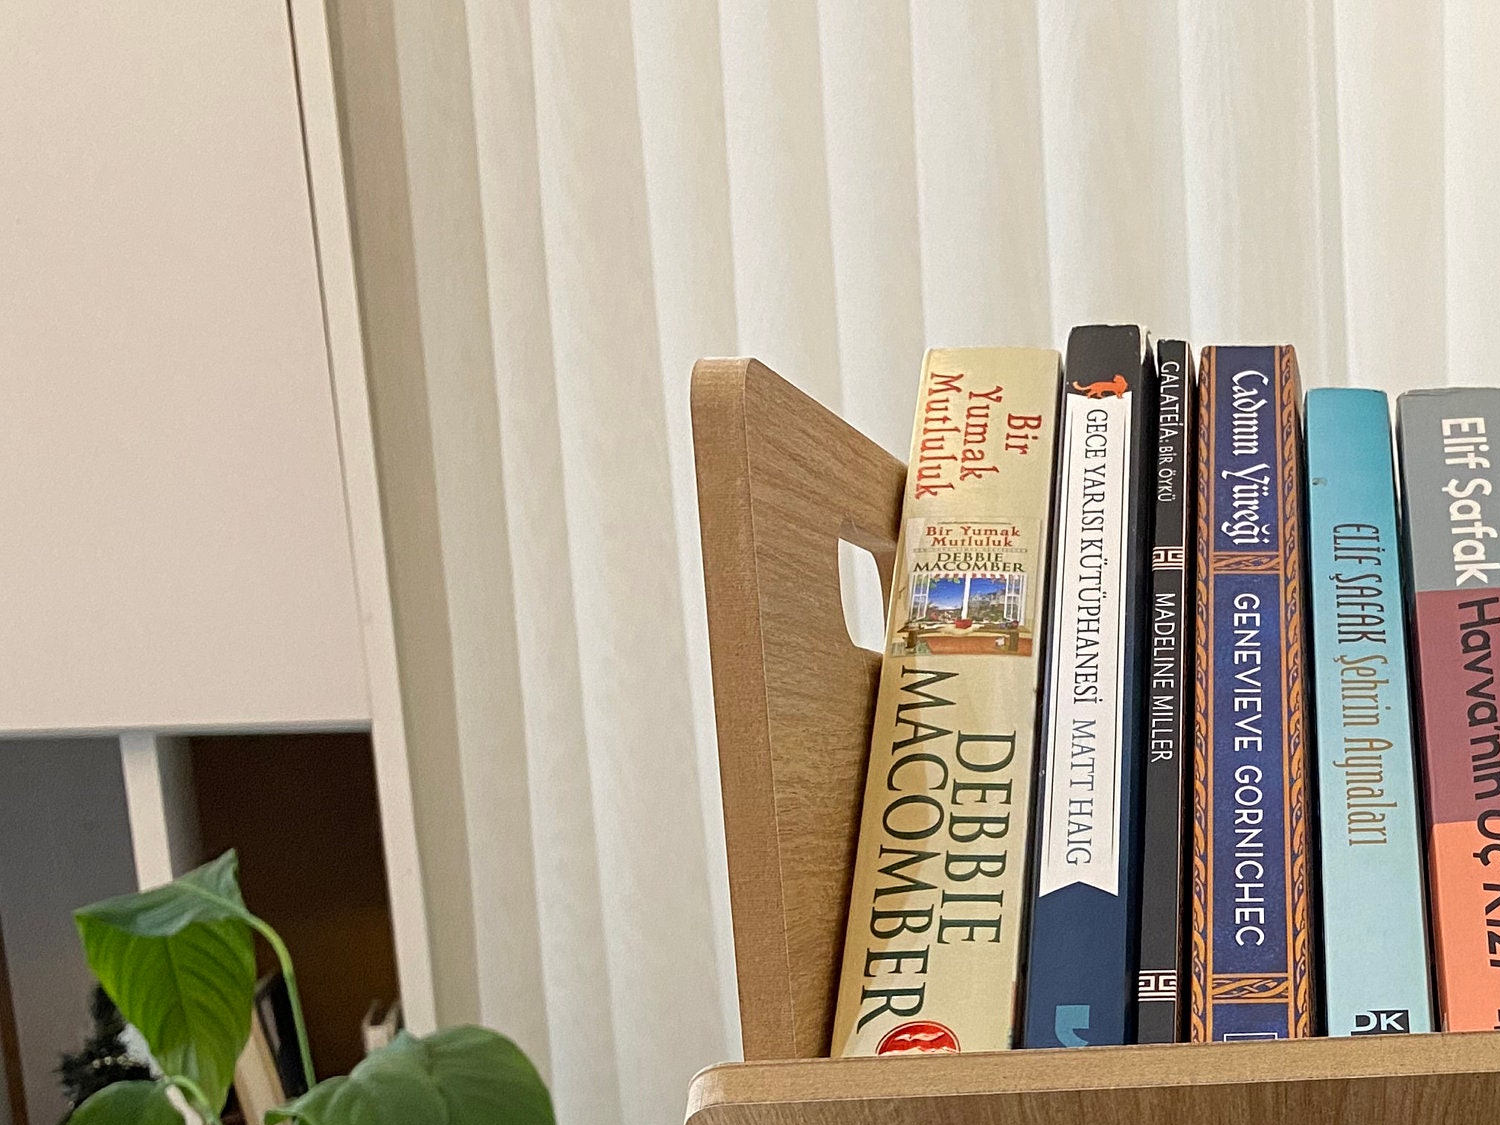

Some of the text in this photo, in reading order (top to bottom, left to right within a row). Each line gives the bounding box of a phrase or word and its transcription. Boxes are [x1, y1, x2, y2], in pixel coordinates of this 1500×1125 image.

[914, 371, 965, 500] Mutluluk
[959, 385, 1004, 482] Yumak
[1004, 412, 1043, 455] Bir
[1157, 360, 1184, 502] GALATEİA: BİR ÖYKÜ
[1220, 369, 1271, 546] Cadının Yüreği
[1441, 416, 1500, 587] Elif Şafak
[913, 562, 1025, 573] MACOMBER
[925, 525, 1021, 537] Bir Yumak
[930, 537, 1014, 547] Mutluluk
[937, 552, 1004, 562] DEBBIE
[1074, 409, 1109, 705] GECE YARISI KÜTÜPHANESİ
[1150, 592, 1176, 763] MADELINE MILLER
[1329, 572, 1387, 645] ŞAFAK
[1065, 717, 1097, 867] MATT HAIG
[1232, 592, 1266, 947] GENEVIEVE GORNICHEC
[1333, 654, 1398, 847] Şehrin Aynaları
[856, 664, 960, 1034] MACOMBER
[936, 729, 1017, 945] DEBBIE
[1352, 1011, 1405, 1032] DK
